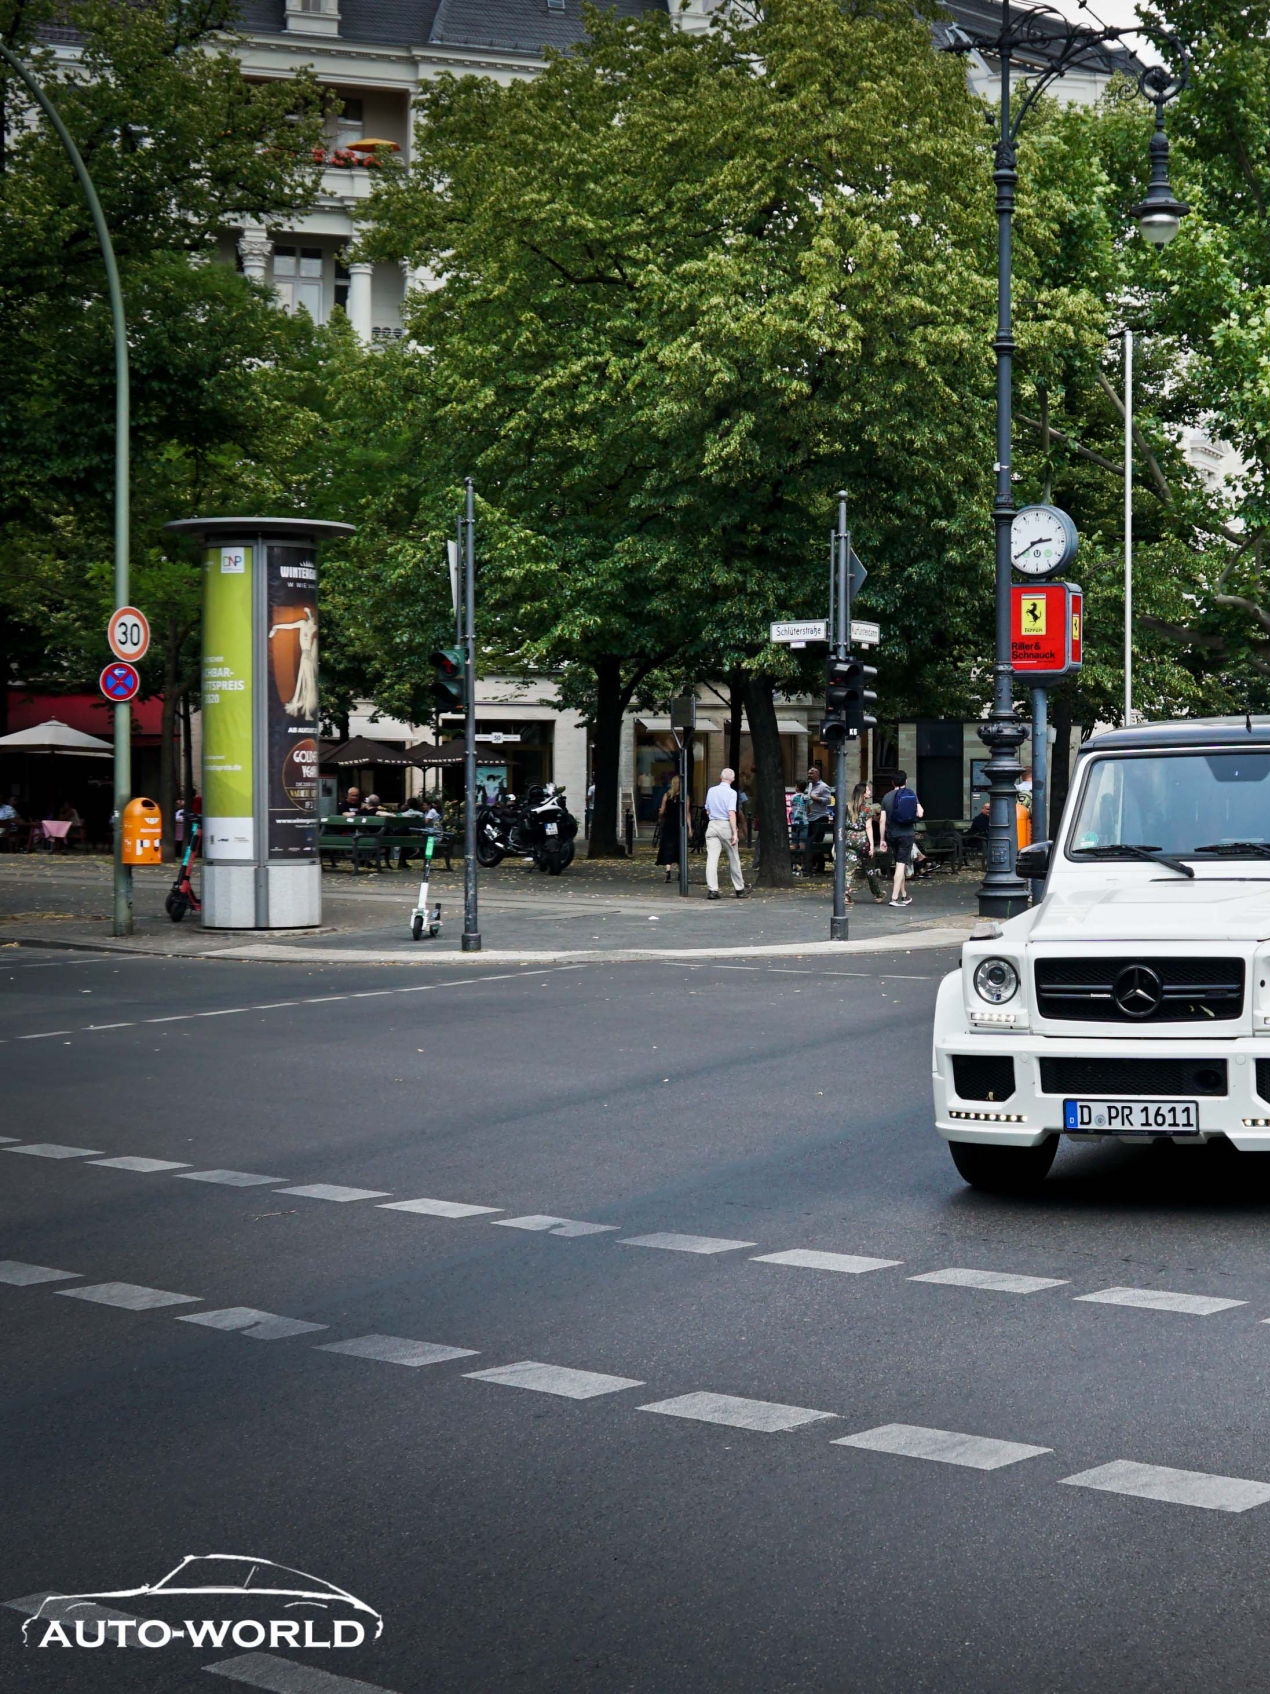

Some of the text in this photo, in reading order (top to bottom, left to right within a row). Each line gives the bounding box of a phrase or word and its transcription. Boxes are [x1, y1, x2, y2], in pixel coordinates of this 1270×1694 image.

[223, 556, 242, 566] DNP
[118, 622, 140, 646] 30
[776, 626, 821, 636] Schlüterstraße
[1012, 642, 1041, 650] Riller &
[1012, 650, 1055, 659] Schnauck
[1079, 1105, 1194, 1127] D PR 1611
